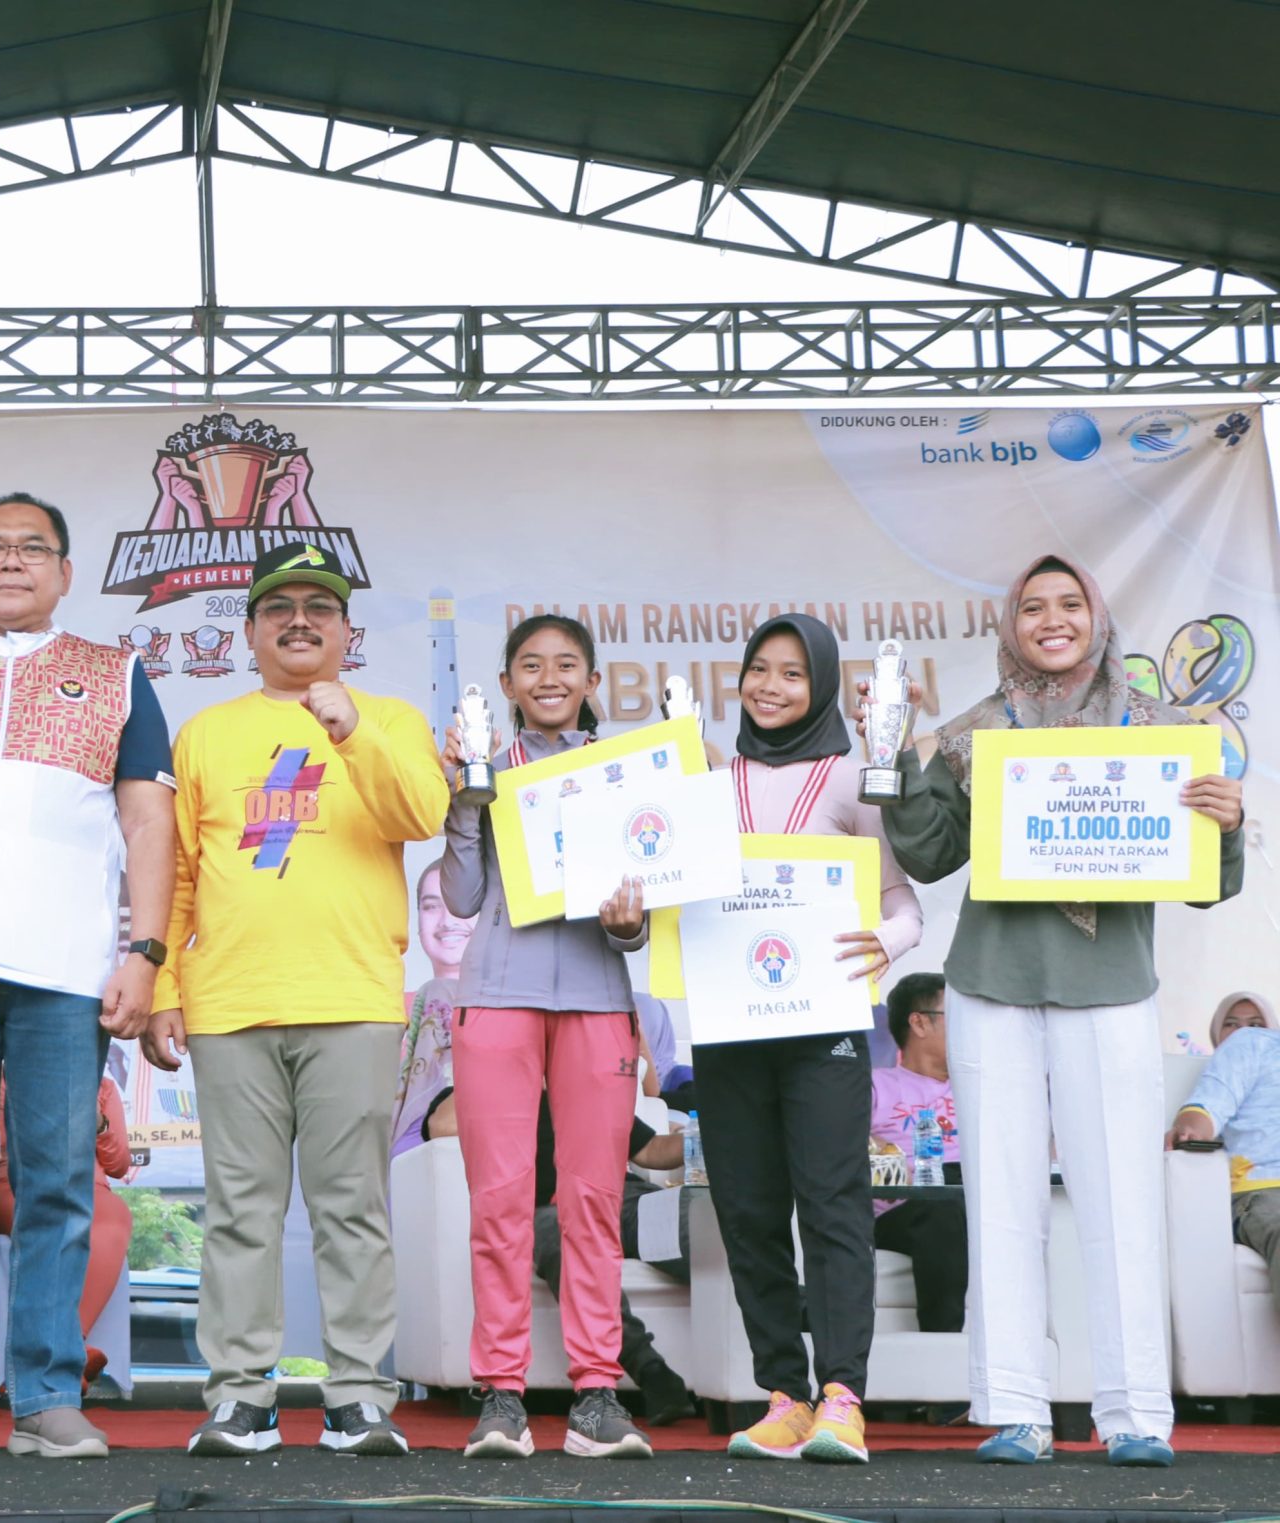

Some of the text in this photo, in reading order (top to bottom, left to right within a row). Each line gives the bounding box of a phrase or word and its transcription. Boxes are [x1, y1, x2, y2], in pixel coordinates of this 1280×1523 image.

[820, 416, 897, 428] DIDUKUNG
[900, 415, 939, 428] OLEH
[921, 441, 1038, 466] bank bjb
[106, 529, 258, 588] KEJUARAAN
[183, 569, 254, 585] KEMENP
[205, 596, 249, 618] 202
[505, 600, 1001, 644] DAM RANGKN HARI JA
[1231, 704, 1248, 717] th
[1066, 785, 1121, 797] JUARA 1
[245, 789, 319, 825] ORB
[1046, 801, 1145, 813] UMUM PUTRI
[1026, 815, 1171, 843] Rp.1.000.000
[1029, 846, 1169, 857] KEJUARAN TARKAM
[1054, 863, 1142, 874] FUN RUN 5K
[738, 888, 793, 899] UARA 2
[747, 999, 811, 1016] PIAGAM
[151, 1130, 177, 1142] SE.,
